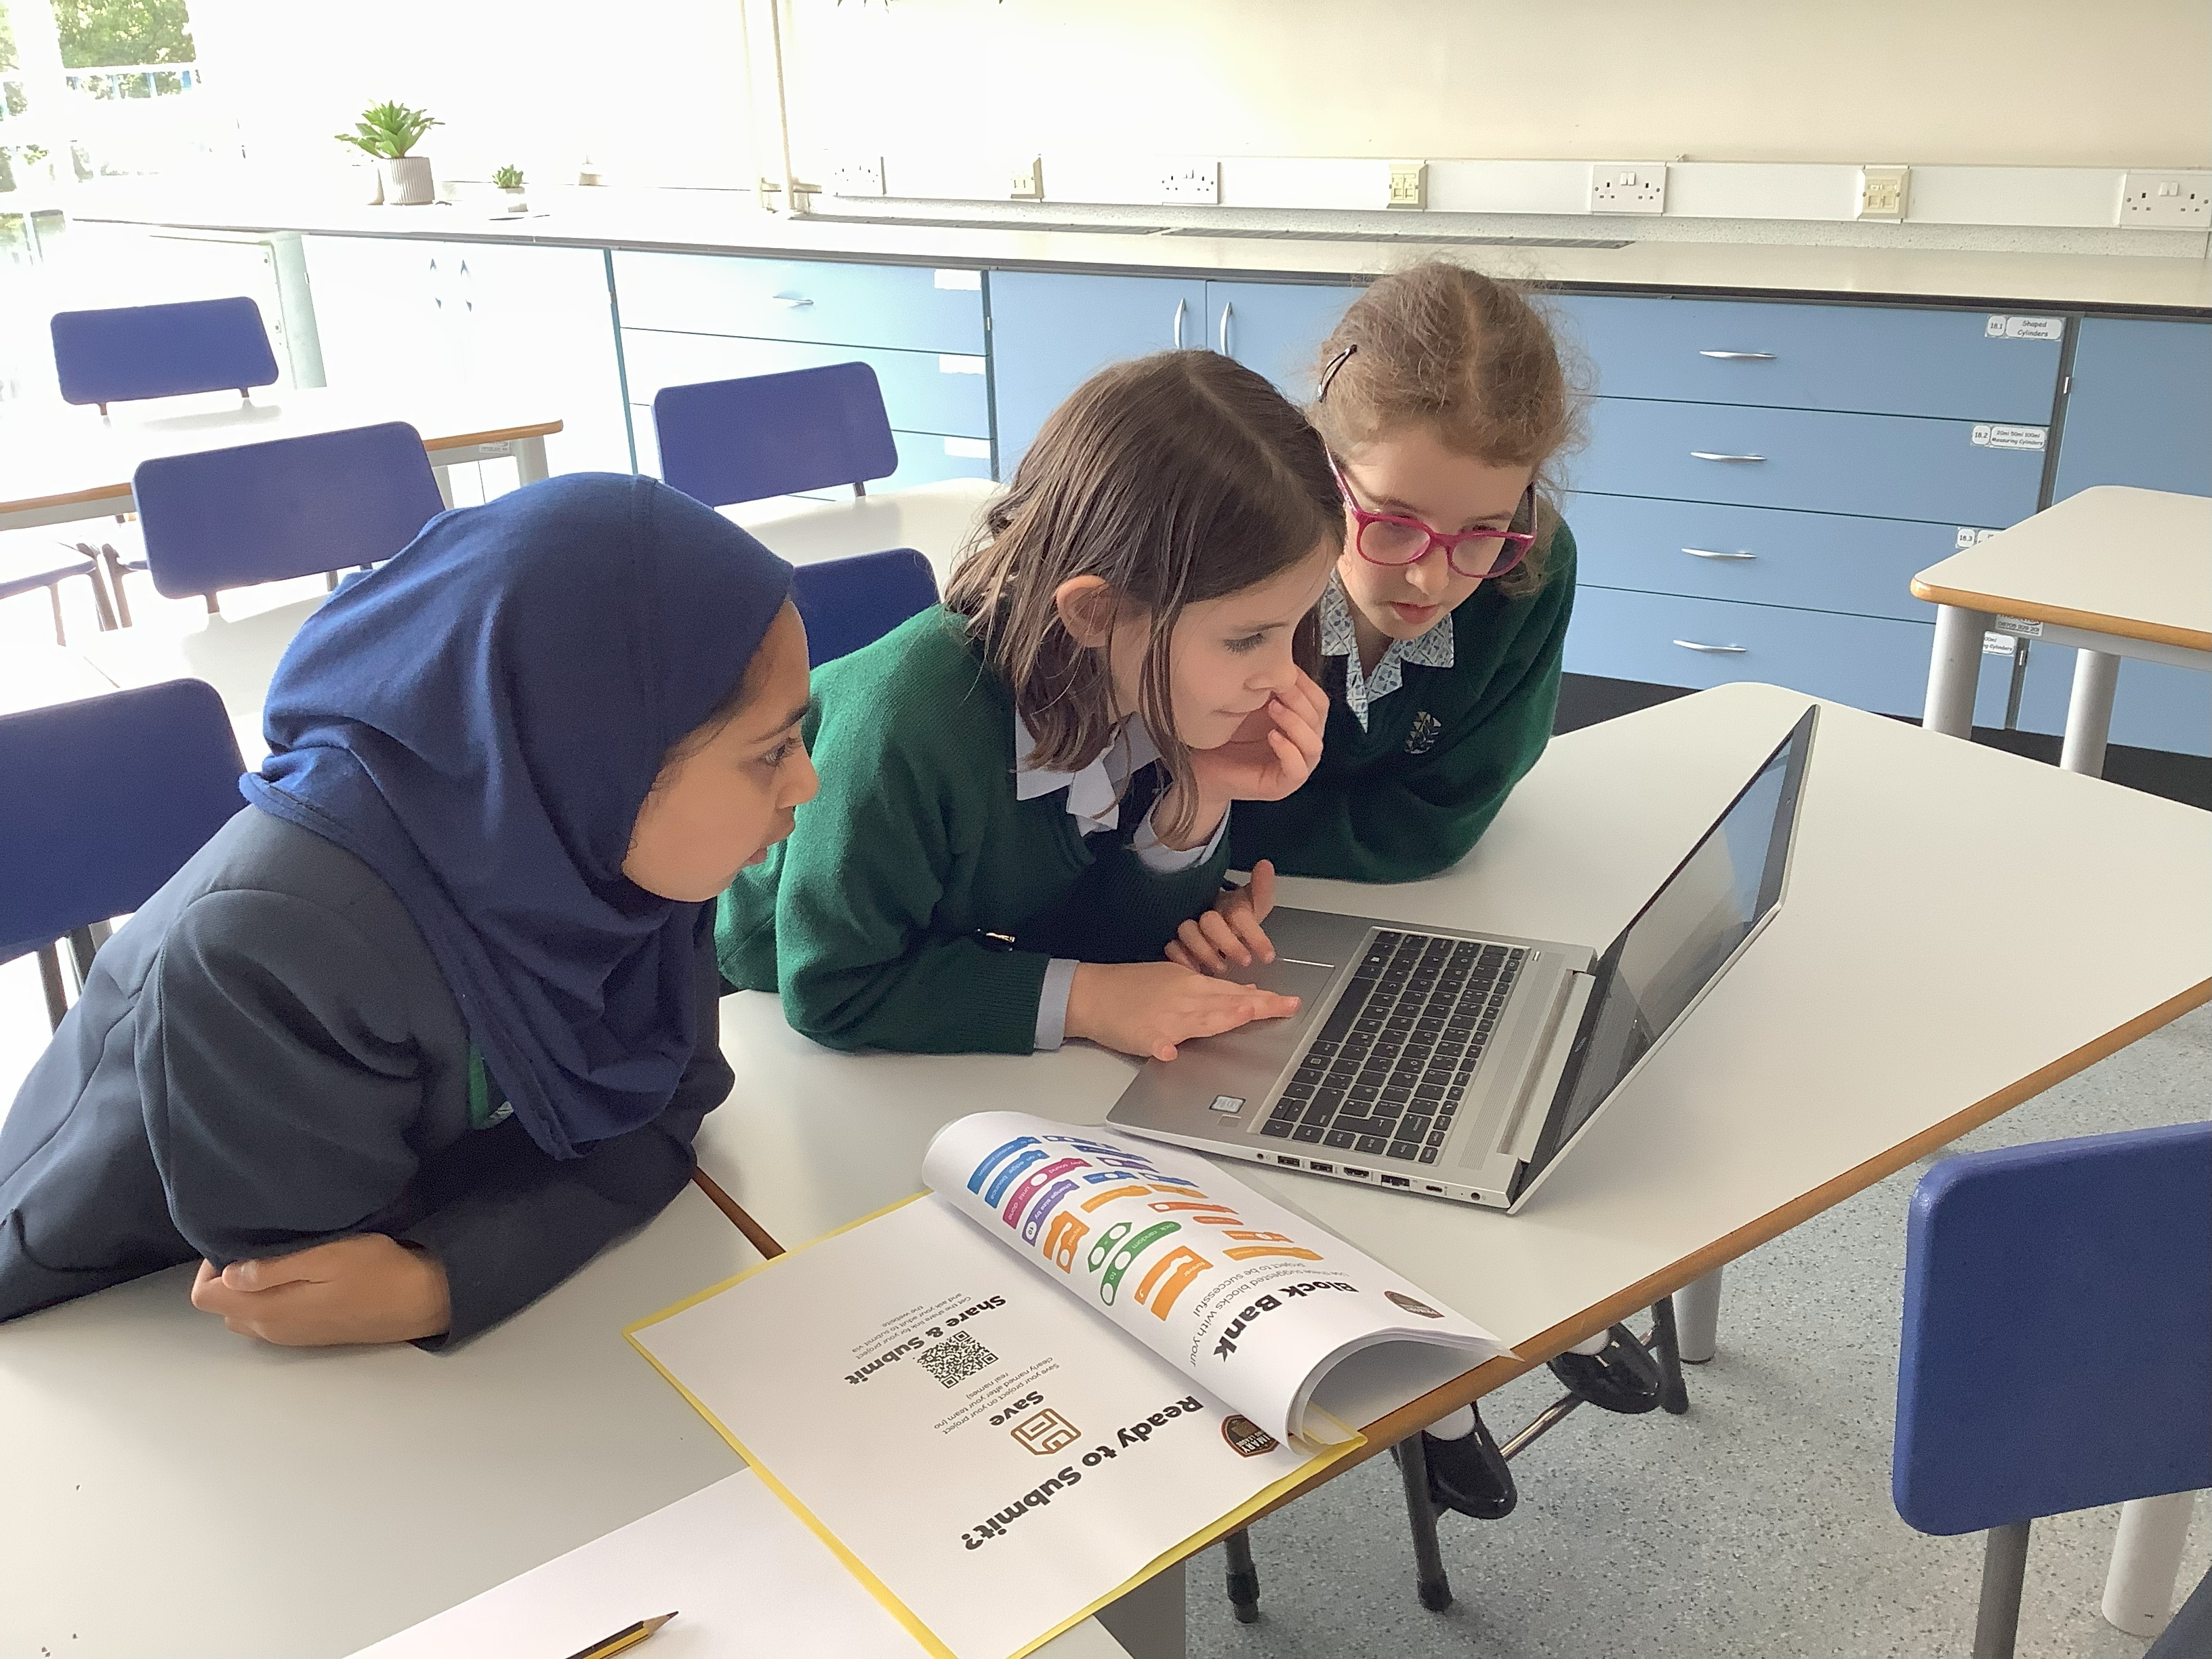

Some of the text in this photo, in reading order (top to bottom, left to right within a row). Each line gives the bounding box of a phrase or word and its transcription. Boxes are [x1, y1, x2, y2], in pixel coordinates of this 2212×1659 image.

[2022, 320, 2047, 328] Shaped
[2018, 329, 2049, 337] Cylinders
[1008, 1161, 1024, 1174] edge
[991, 1175, 1008, 1199] bounce
[1019, 1186, 1030, 1200] until
[1050, 1183, 1071, 1199] change
[1008, 1202, 1018, 1220] done
[1040, 1198, 1051, 1210] size
[1035, 1210, 1042, 1219] by
[1132, 1231, 1157, 1248] random
[1109, 1271, 1116, 1279] to
[1184, 1262, 1205, 1277] forever
[1250, 1270, 1303, 1286] suggested
[947, 1293, 962, 1303] and
[1193, 1274, 1244, 1317] successful
[1215, 1284, 1251, 1309] blocks
[919, 1307, 935, 1317] your
[935, 1300, 947, 1309] ask
[899, 1316, 918, 1327] adult
[911, 1320, 925, 1328] link
[924, 1310, 945, 1322] share
[1197, 1311, 1217, 1336] with
[1213, 1282, 1357, 1362] Block Bank
[844, 1296, 1006, 1385] Share & Submit
[863, 1330, 890, 1346] submit
[883, 1332, 899, 1344] your
[855, 1343, 882, 1359] project
[1190, 1336, 1200, 1367] your
[1041, 1364, 1059, 1374] Save
[966, 1372, 1008, 1399] real names)
[1025, 1372, 1041, 1384] your
[934, 1357, 1052, 1429] clearly named after your team (no
[998, 1382, 1024, 1399] project
[970, 1404, 987, 1418] your
[989, 1391, 1044, 1426] Save
[942, 1416, 969, 1434] project
[1241, 1433, 1271, 1453] IMARY
[962, 1395, 1204, 1550] Ready to Submit?
